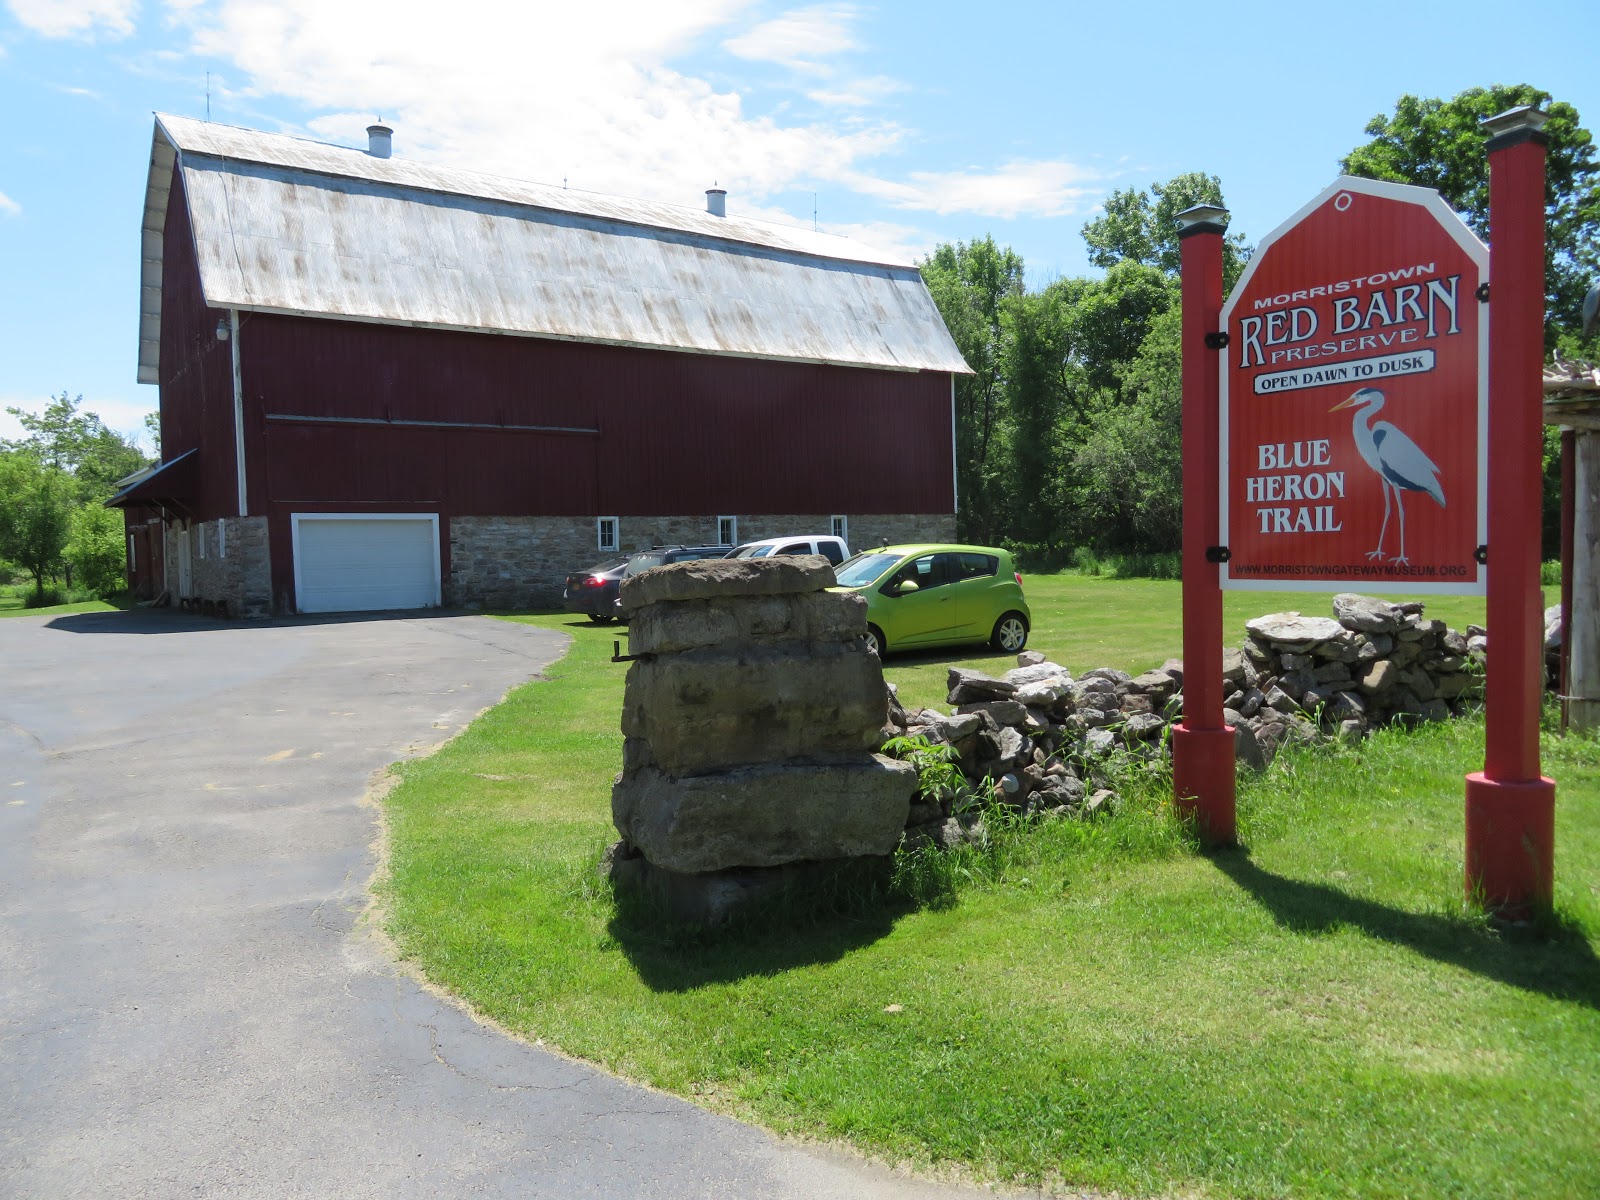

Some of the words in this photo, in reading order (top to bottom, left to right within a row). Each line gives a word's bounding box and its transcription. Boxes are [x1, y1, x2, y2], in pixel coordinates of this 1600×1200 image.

[1254, 262, 1435, 309] MORRISTOWN
[1240, 306, 1318, 368] RED
[1333, 275, 1460, 338] BARN
[1270, 328, 1419, 364] PRESERVE
[1261, 375, 1299, 390] OPEN
[1302, 367, 1348, 385] DAWN
[1352, 363, 1374, 377] TO
[1378, 355, 1424, 372] DUSK
[1257, 439, 1331, 470] BLUE
[1245, 471, 1346, 503] HERON
[1256, 506, 1342, 533] TRAIL
[1235, 564, 1467, 577] WWW.MORRISTOWNGATEWAYMUSEUM.ORG
